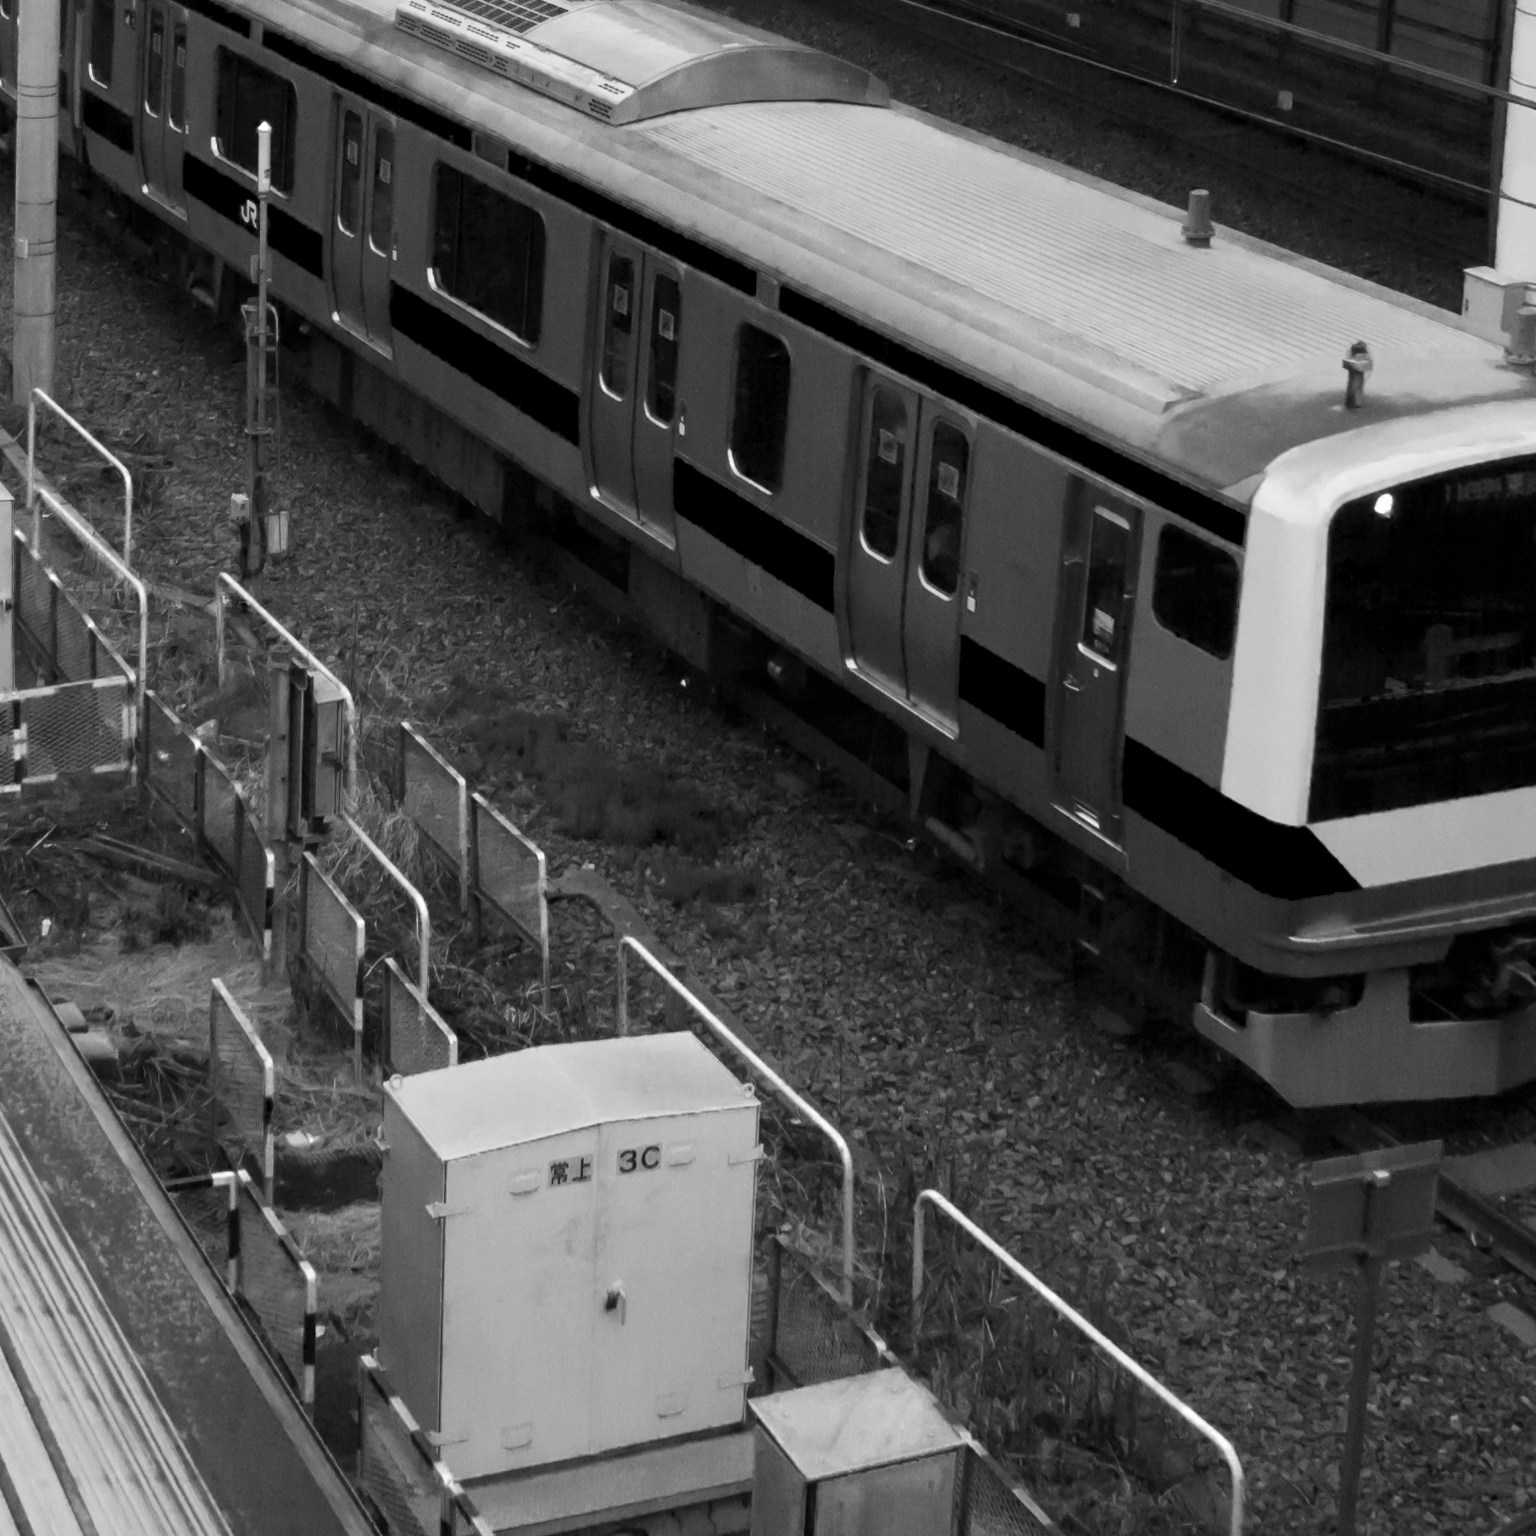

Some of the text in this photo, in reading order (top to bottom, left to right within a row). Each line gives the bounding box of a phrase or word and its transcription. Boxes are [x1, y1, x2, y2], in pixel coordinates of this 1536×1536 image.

[240, 199, 258, 229] JR
[550, 1145, 660, 1186] 常上 3C
